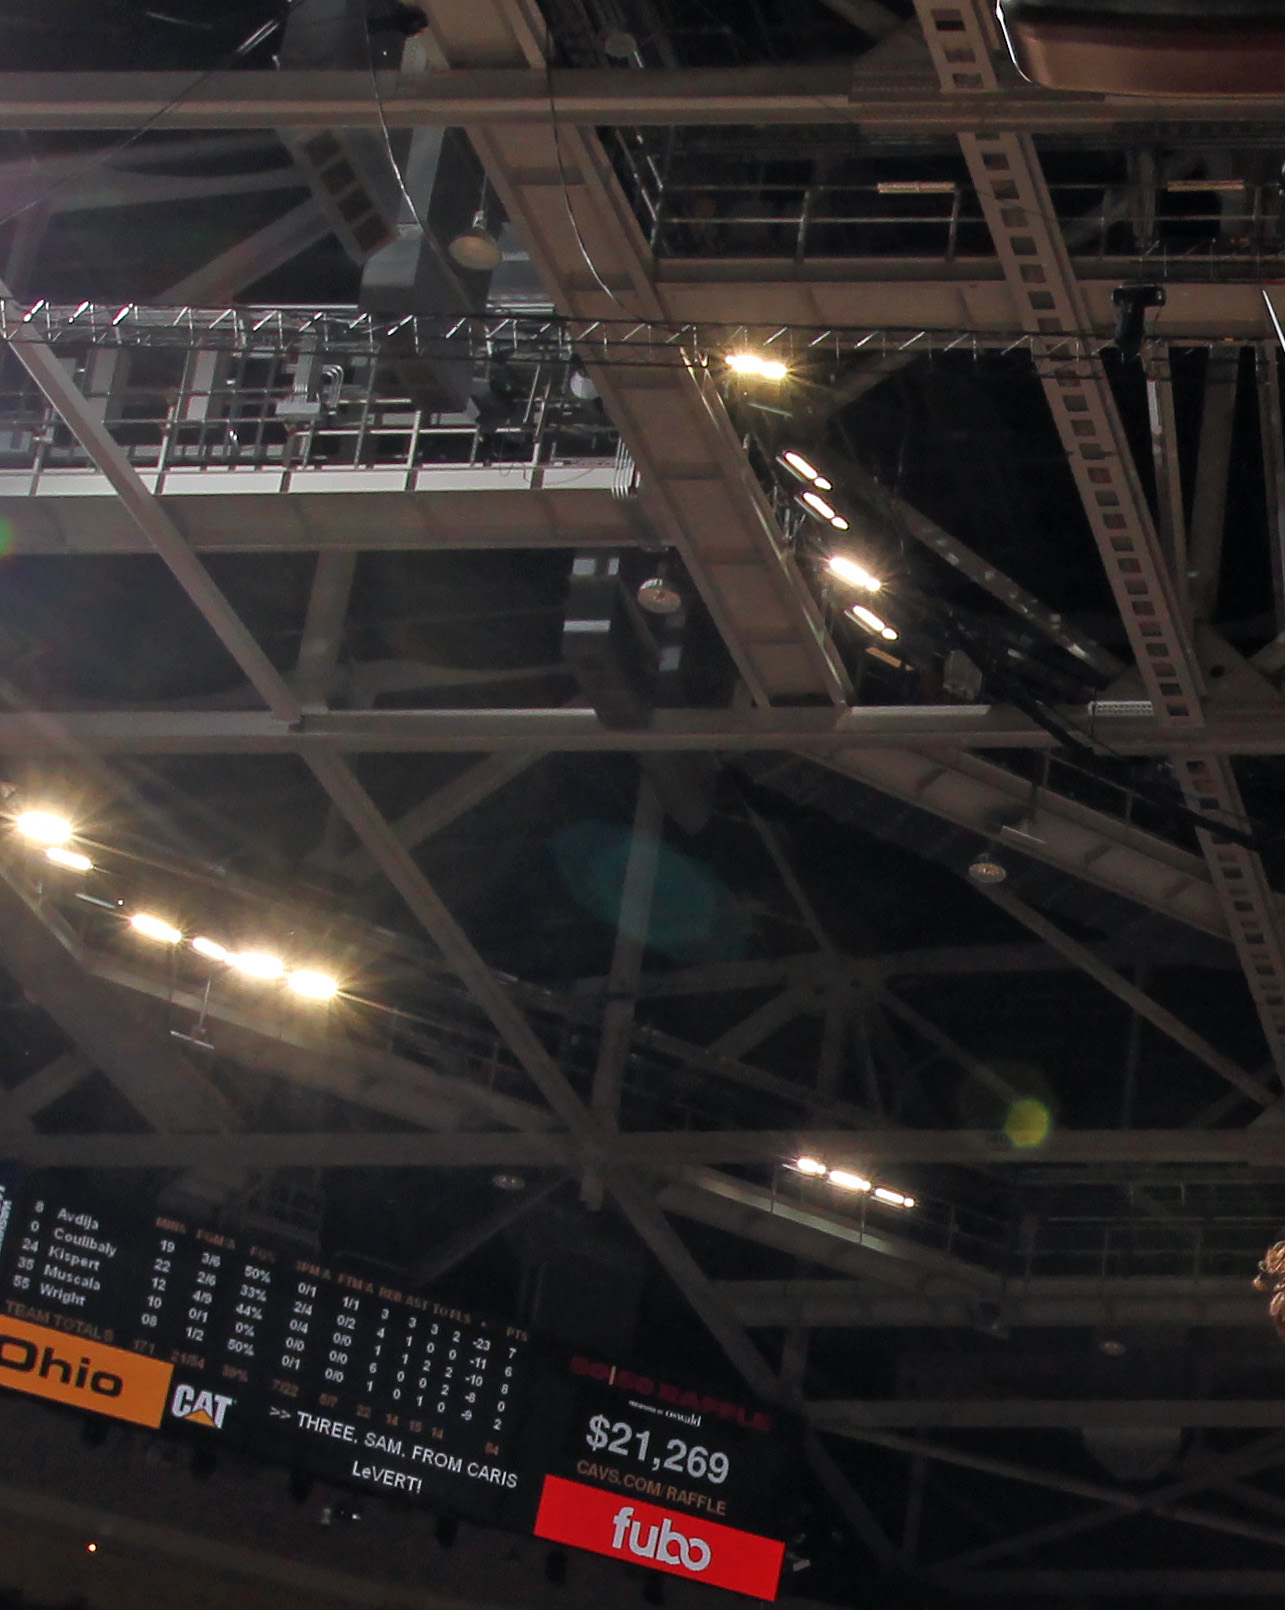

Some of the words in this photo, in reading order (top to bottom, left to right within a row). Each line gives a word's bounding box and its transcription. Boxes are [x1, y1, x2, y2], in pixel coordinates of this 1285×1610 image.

[57, 1209, 99, 1230] Avdija
[48, 1247, 100, 1272] Kispert
[54, 1228, 117, 1257] Coulibaly
[40, 1283, 86, 1306] Wright
[44, 1265, 101, 1291] Muscala
[0, 1335, 123, 1398] Ohio
[170, 1383, 233, 1429] CAT
[297, 1410, 358, 1444] THREE.
[364, 1433, 406, 1458] SAM.
[411, 1446, 463, 1473] FROM
[467, 1462, 519, 1488] CARIS
[586, 1414, 729, 1484] $21,269
[352, 1460, 423, 1494] LeVERT!
[577, 1459, 726, 1516] CAVS.COM/RAFFLE
[612, 1506, 712, 1571] fubo
